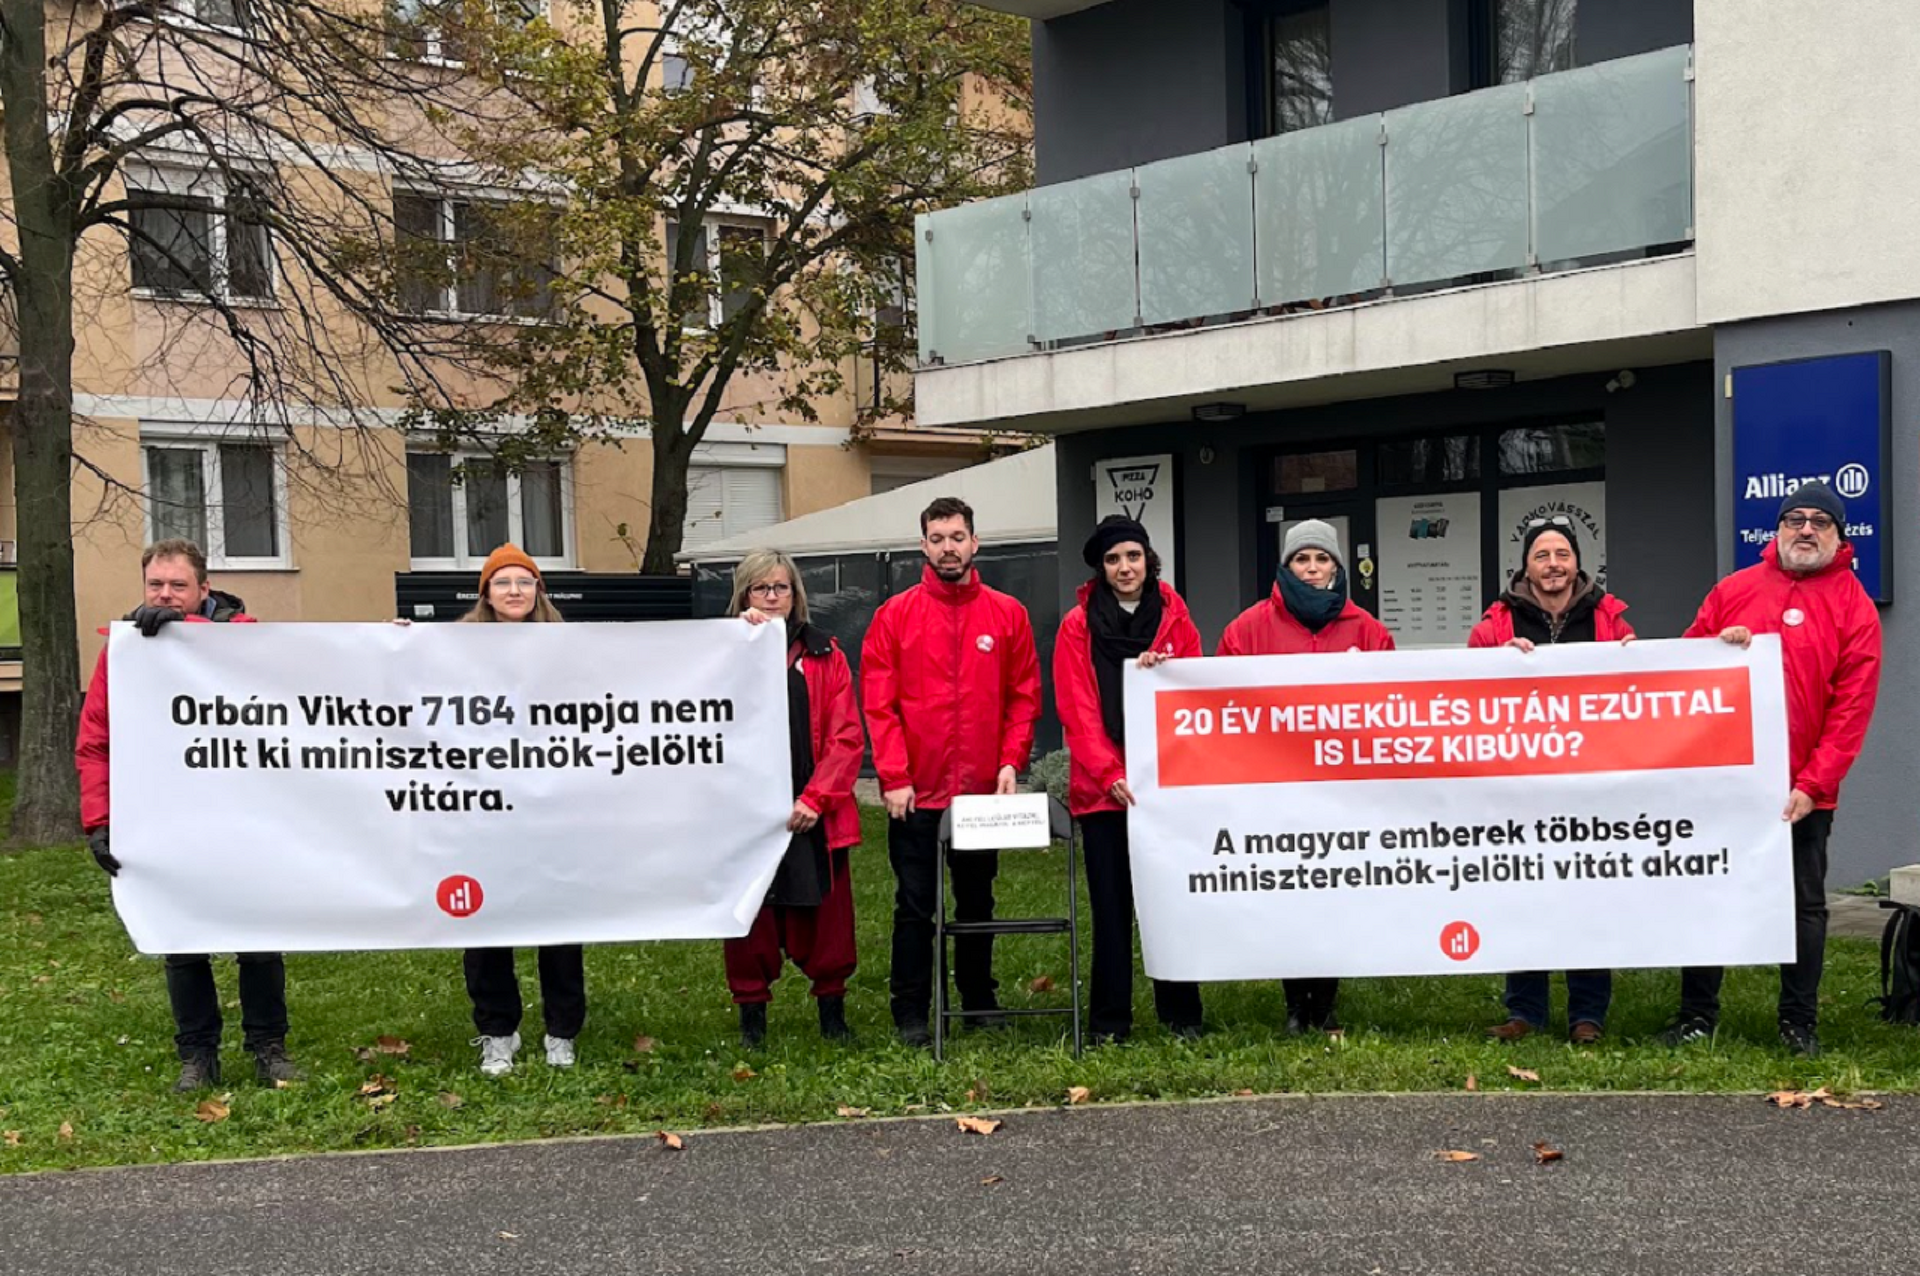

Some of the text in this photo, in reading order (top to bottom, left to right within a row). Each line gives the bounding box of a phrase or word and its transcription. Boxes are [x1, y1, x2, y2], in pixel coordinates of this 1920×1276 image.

[1114, 487, 1154, 503] KOHO
[1122, 472, 1146, 482] PIZZA
[171, 692, 734, 734] Orbán Viktor 7164 napja nem
[1174, 685, 1735, 736] 20 ÉV MENEKÜLÉS UTÁN EZÚTTAL
[184, 732, 724, 776] állt ki miniszterelnök-jelölti
[1314, 725, 1584, 766] IS LESZ KIBÚVÓ?
[385, 780, 514, 812] vitára.
[1213, 813, 1694, 860] A magyar emberek többsége
[1188, 847, 1729, 893] miniszterelnök-jelölti vitát akar!
